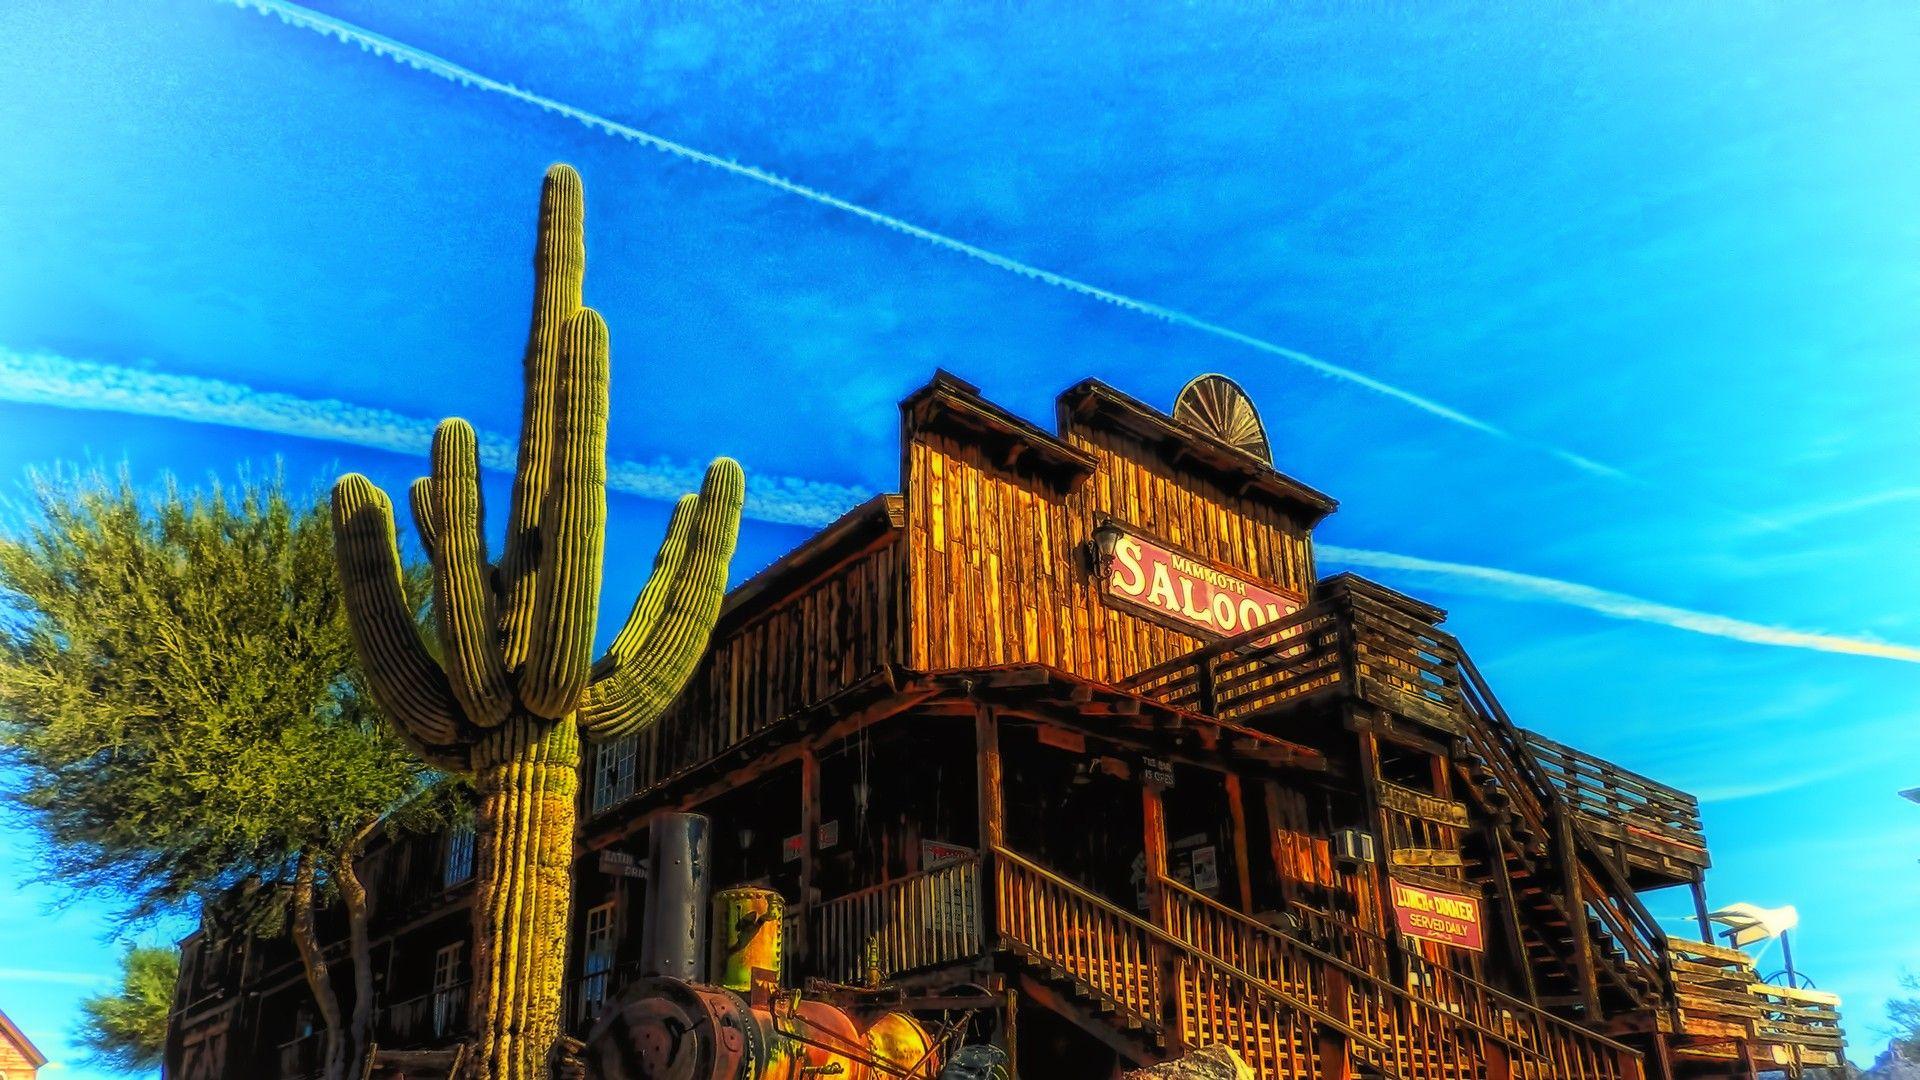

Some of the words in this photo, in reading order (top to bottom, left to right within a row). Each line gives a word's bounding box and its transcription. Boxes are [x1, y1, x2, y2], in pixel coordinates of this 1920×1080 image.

[1171, 554, 1247, 596] MAMMOTH
[1396, 887, 1430, 911] LUNCH
[1433, 896, 1476, 922] DINNER
[1409, 914, 1445, 932] SERVED
[1445, 920, 1468, 937] DAILY
